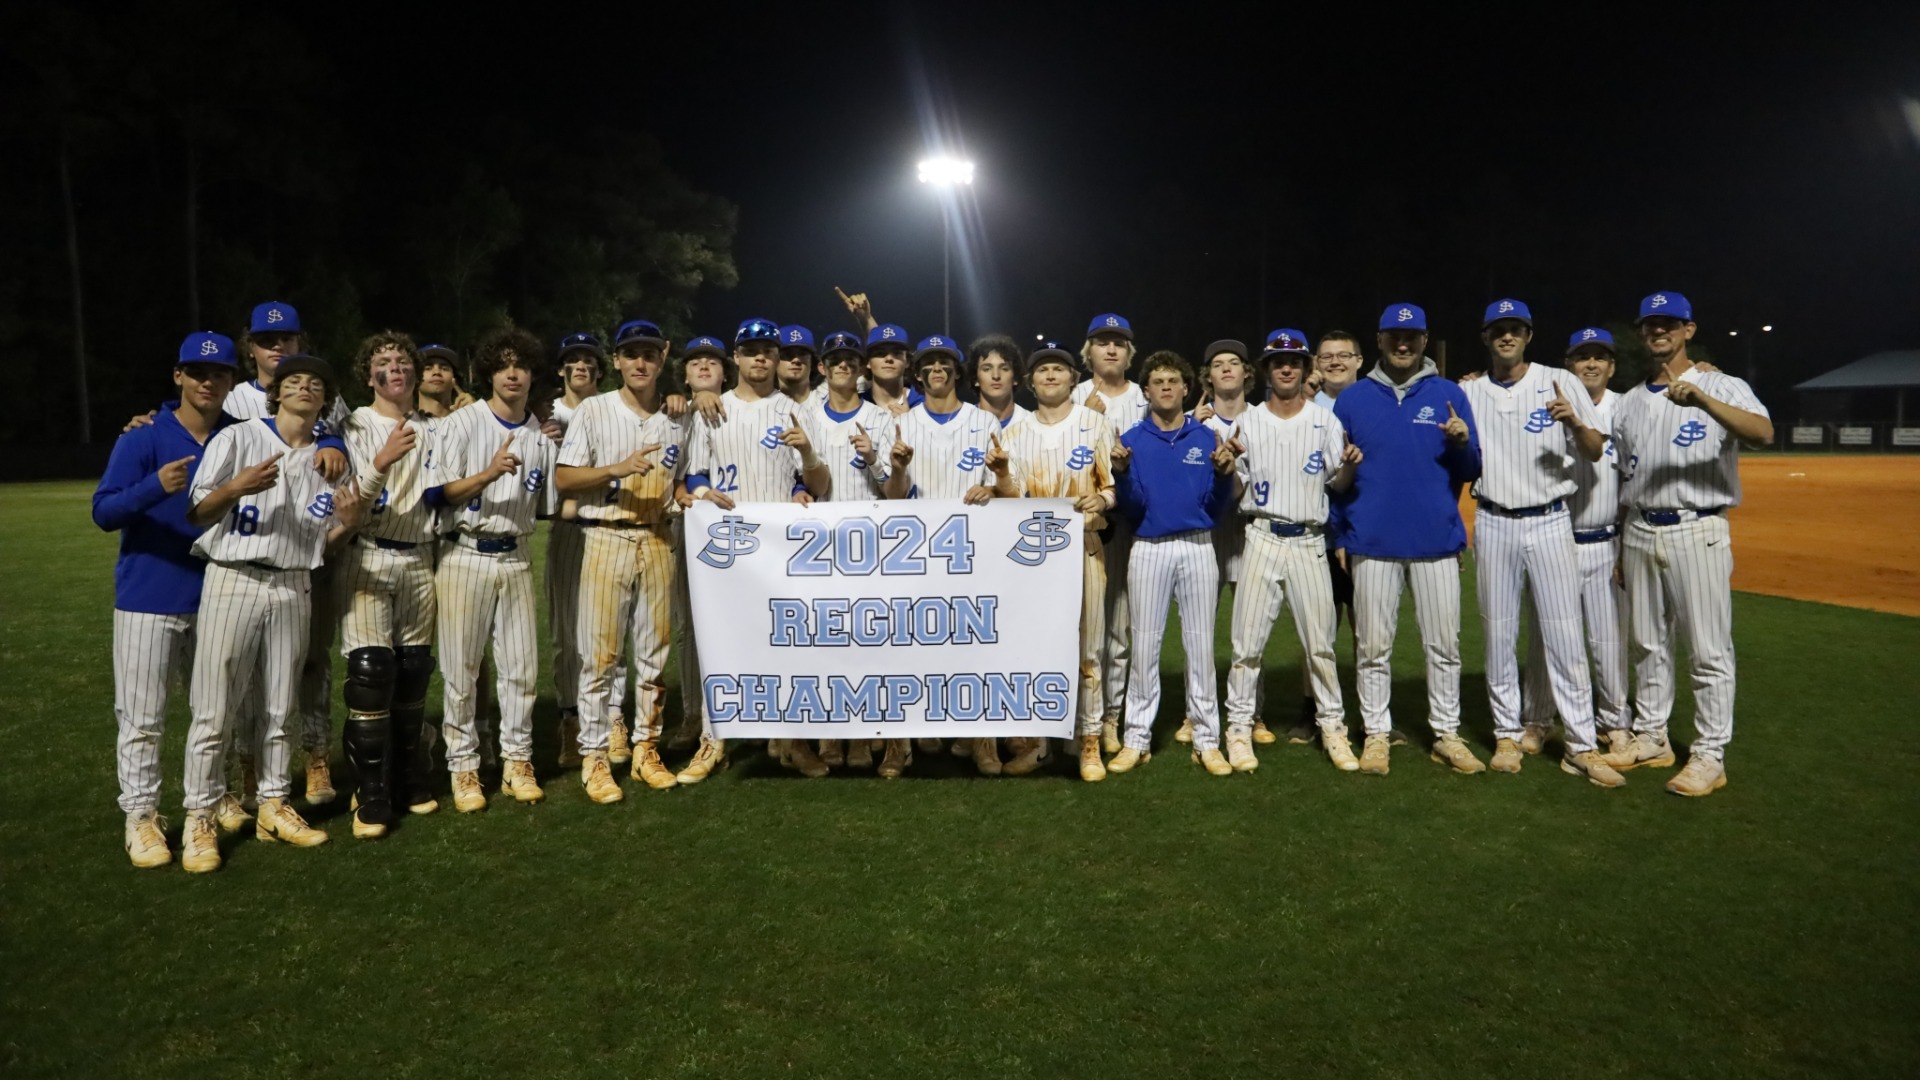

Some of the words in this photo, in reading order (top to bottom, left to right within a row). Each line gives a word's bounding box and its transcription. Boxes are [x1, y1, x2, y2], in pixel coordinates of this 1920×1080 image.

[717, 463, 739, 493] 22
[231, 504, 259, 536] 18
[785, 514, 975, 577] 2024
[768, 595, 999, 647] REGION
[704, 672, 1070, 723] CHAMPIONS
